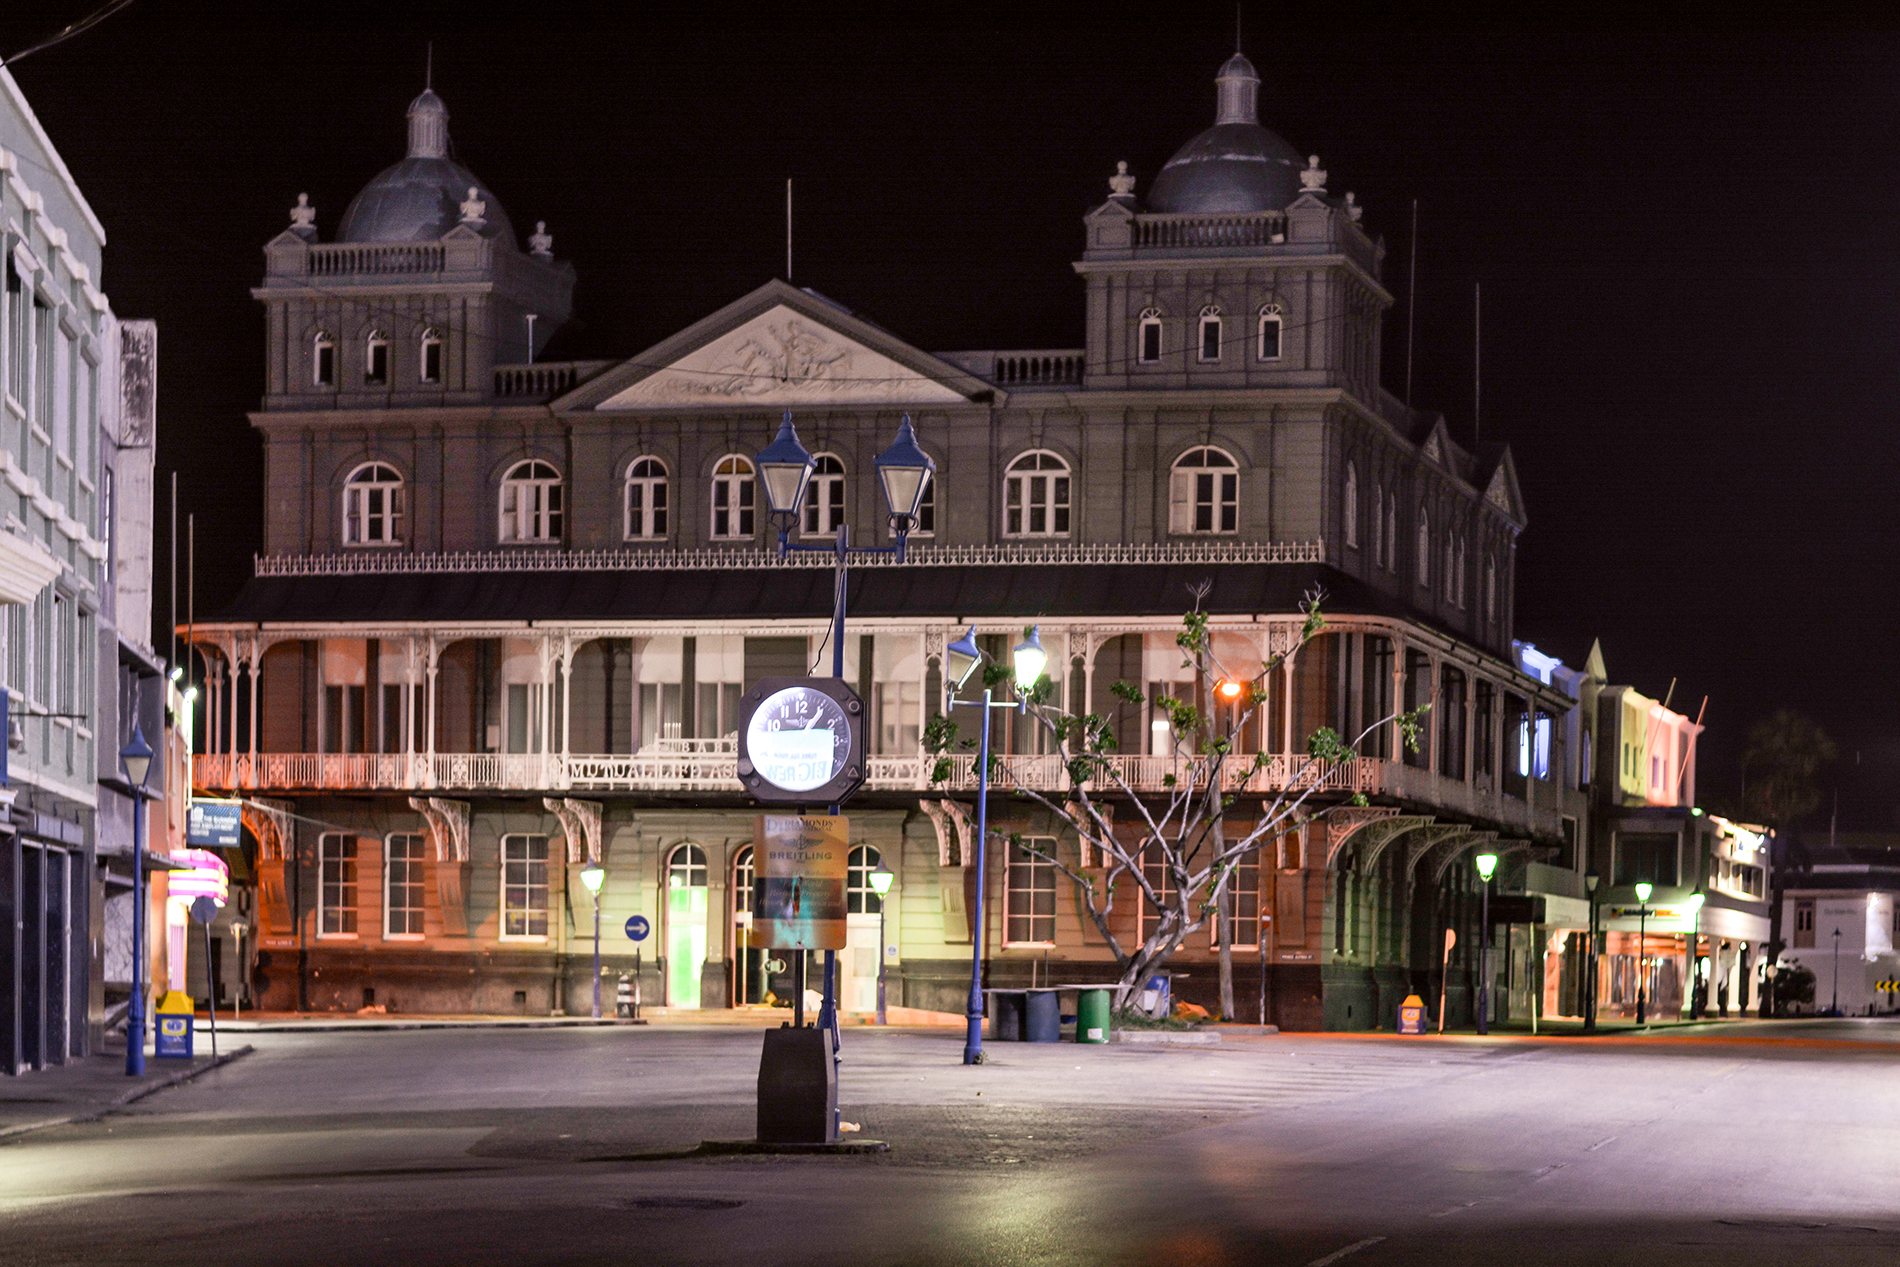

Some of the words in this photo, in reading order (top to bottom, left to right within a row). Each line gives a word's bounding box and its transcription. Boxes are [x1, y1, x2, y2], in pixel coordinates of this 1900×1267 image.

[781, 705, 789, 718] 11
[796, 701, 808, 713] 12
[767, 719, 781, 732] 10
[571, 764, 655, 778] MUTUAL
[661, 764, 702, 778] LIFE
[769, 851, 833, 860] BREITLING
